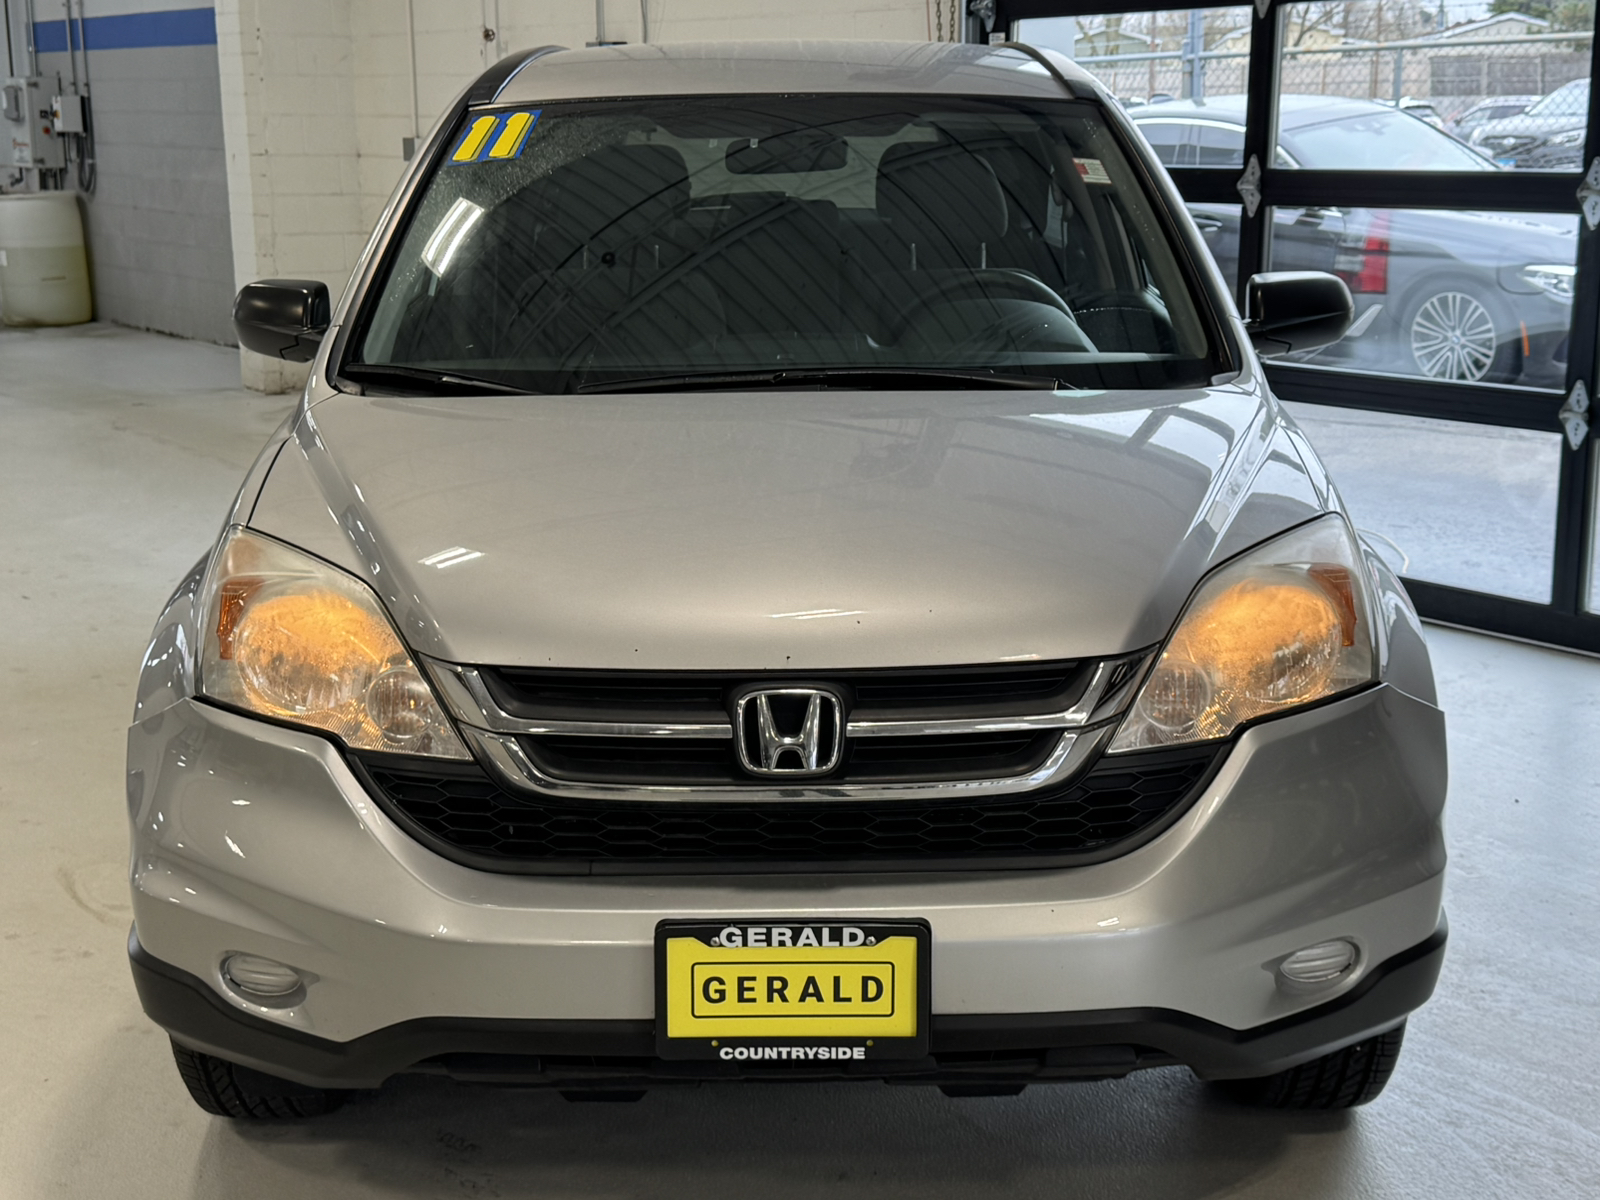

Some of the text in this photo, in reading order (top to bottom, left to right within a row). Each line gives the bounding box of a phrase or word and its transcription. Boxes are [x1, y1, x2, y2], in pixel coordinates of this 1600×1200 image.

[452, 112, 535, 162] 11
[719, 927, 865, 948] GERALD
[702, 975, 884, 1004] GERALD
[719, 1047, 866, 1060] COUNTRYSIDE
